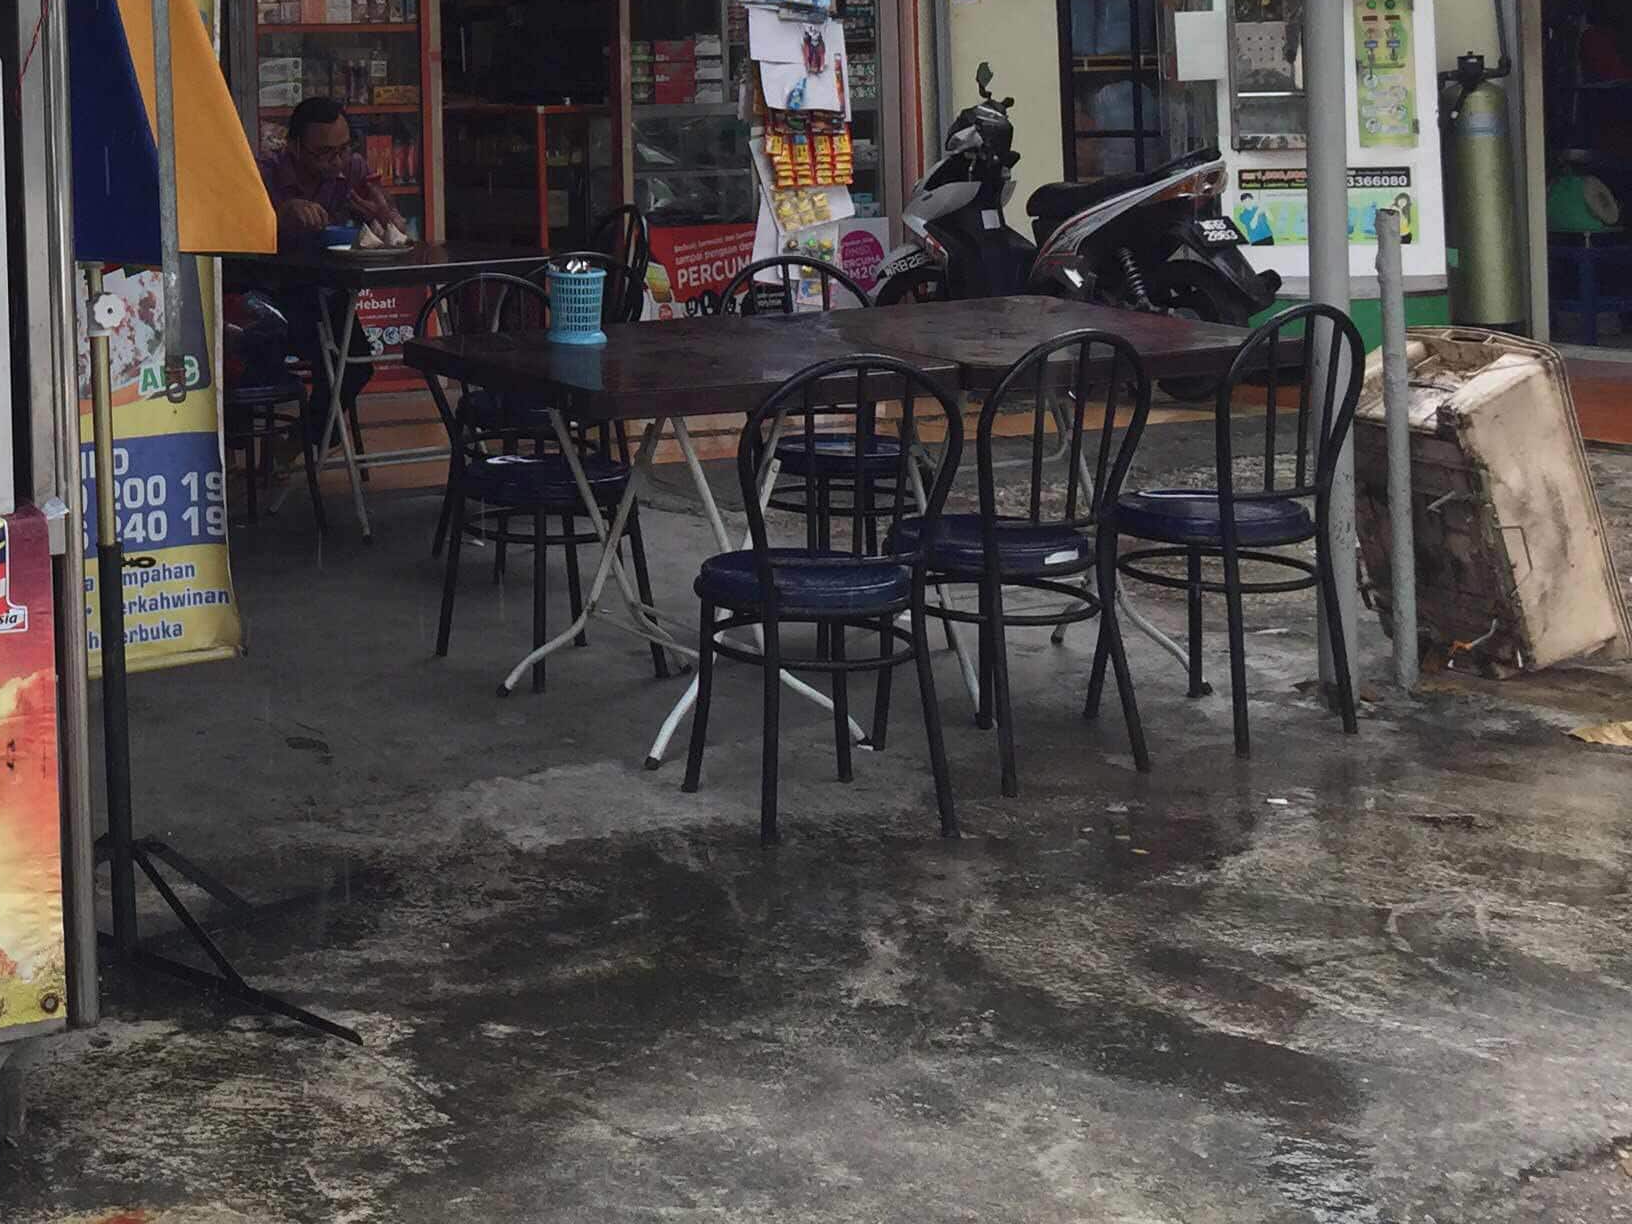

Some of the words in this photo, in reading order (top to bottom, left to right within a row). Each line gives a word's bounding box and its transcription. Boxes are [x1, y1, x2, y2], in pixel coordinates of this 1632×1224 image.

[1347, 175, 1408, 187] 3366080
[676, 254, 752, 289] PERCUM
[121, 562, 197, 589] mpahan
[121, 587, 231, 616] erkahwinan
[122, 620, 184, 645] erbuka
